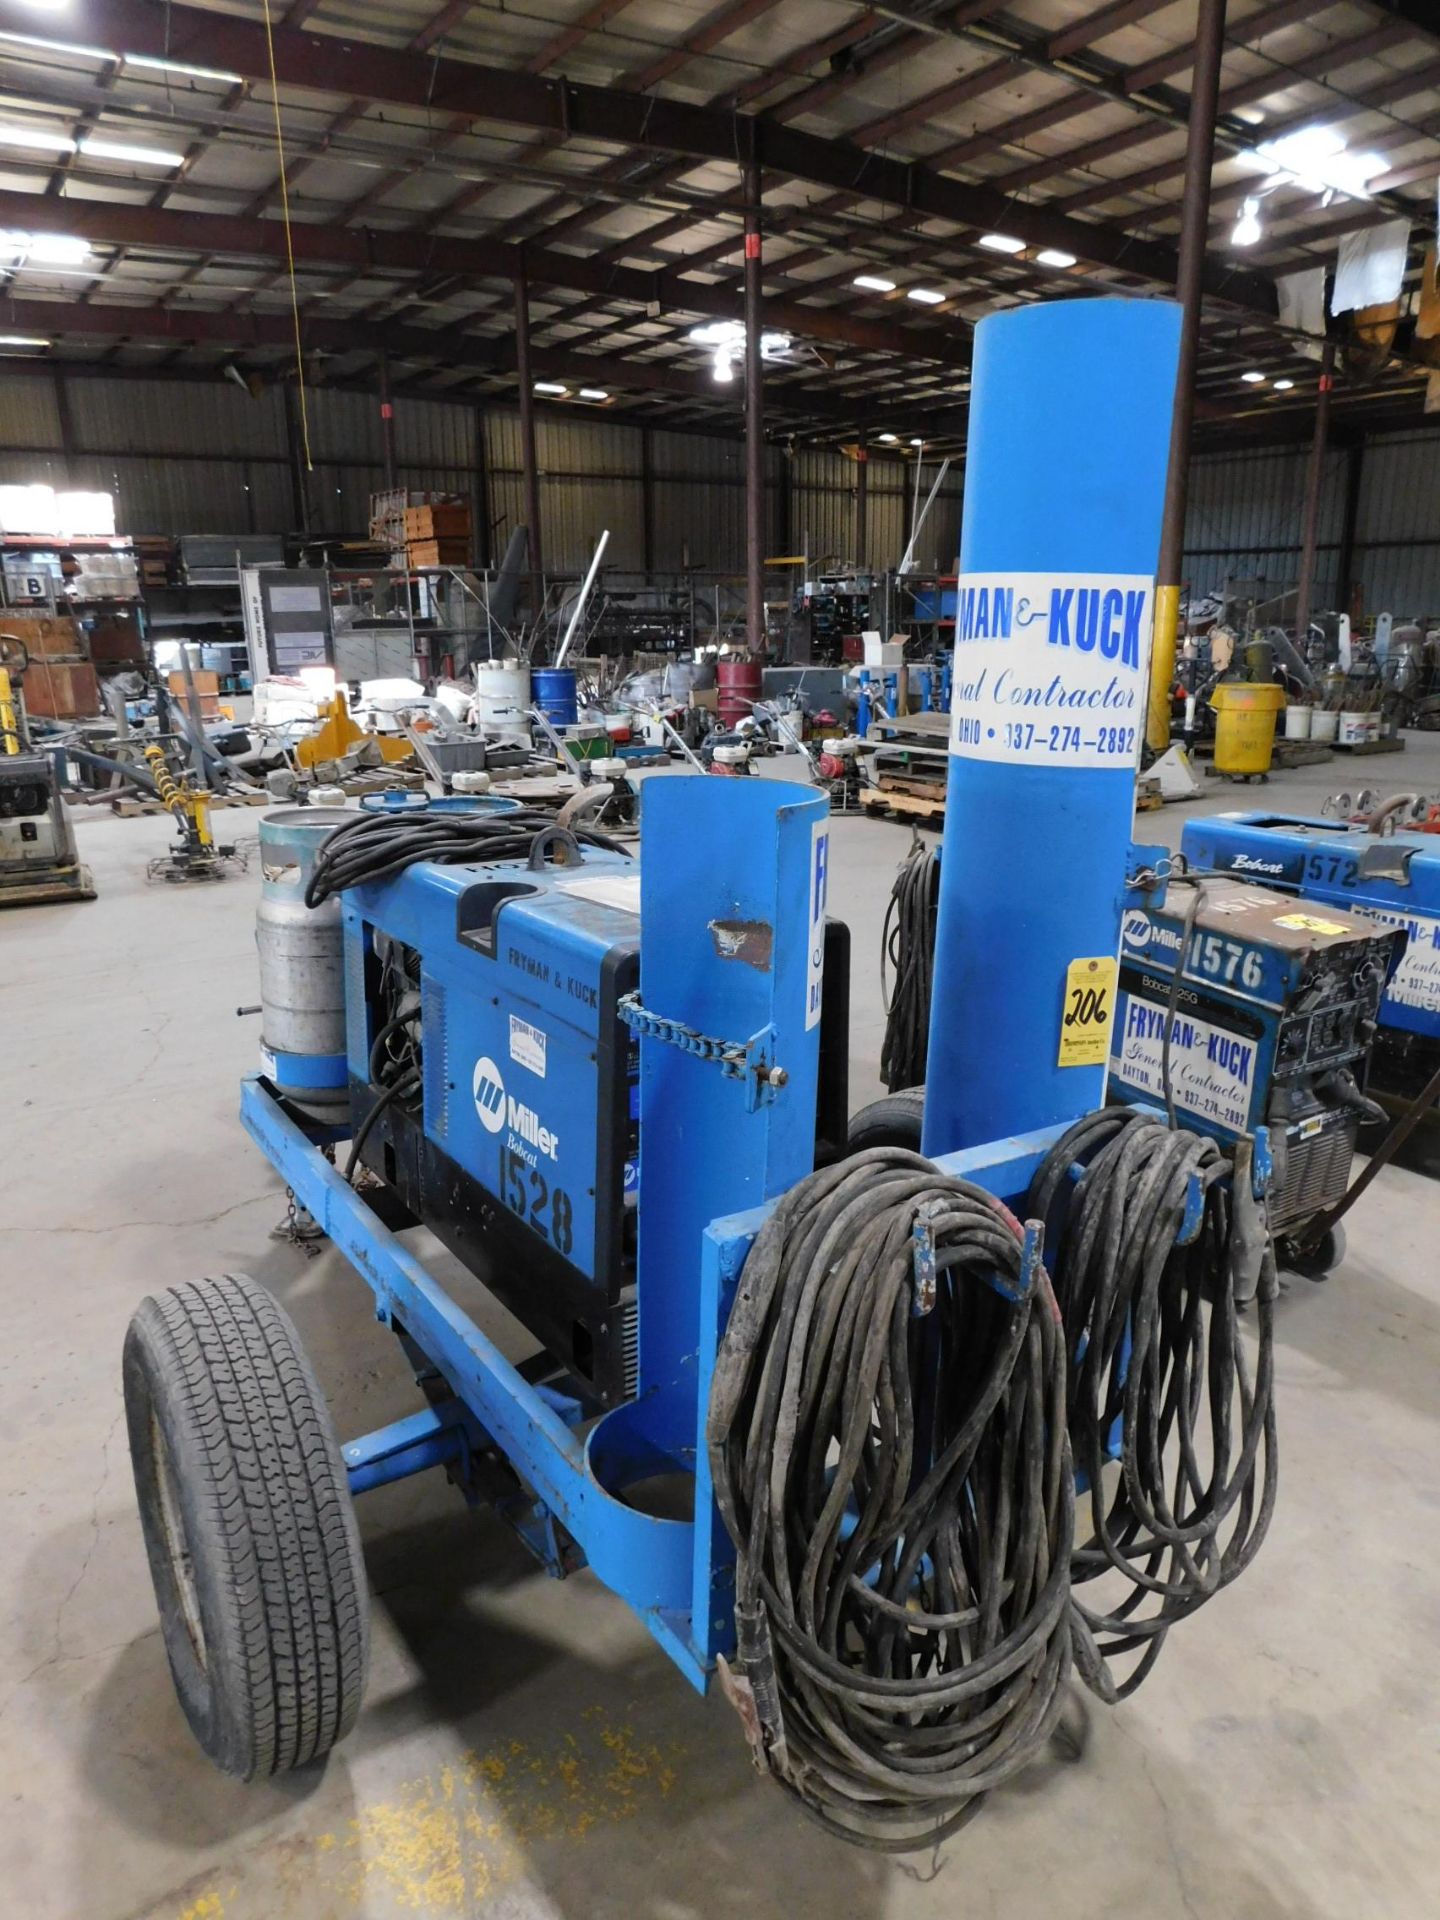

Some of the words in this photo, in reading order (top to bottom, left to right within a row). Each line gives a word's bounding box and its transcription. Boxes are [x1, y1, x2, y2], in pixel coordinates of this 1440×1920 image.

[26, 578, 42, 595] B
[1015, 597, 1048, 627] &
[1048, 587, 1146, 670] KUCK
[993, 668, 1135, 709] Contractor
[959, 717, 981, 745] OHIO
[1230, 853, 1285, 874] Bobcat
[1300, 853, 1359, 888] 1572
[1211, 896, 1278, 915] 1576
[1151, 925, 1184, 951] Mille
[508, 946, 550, 983] FRYMAN
[554, 970, 562, 990] &
[567, 976, 598, 1010] KUCK
[1190, 933, 1264, 989] 1576
[1064, 987, 1108, 1027] 206
[1142, 974, 1172, 995] Bobcat
[1176, 987, 1199, 1006] 25G
[1125, 1042, 1178, 1073] Generl
[1181, 1062, 1246, 1104] Contractor
[1194, 1031, 1208, 1048] &
[1206, 1032, 1252, 1086] KUCK
[508, 1095, 559, 1162] Miller
[506, 1132, 538, 1169] Bobcat
[500, 1143, 573, 1256] 1528
